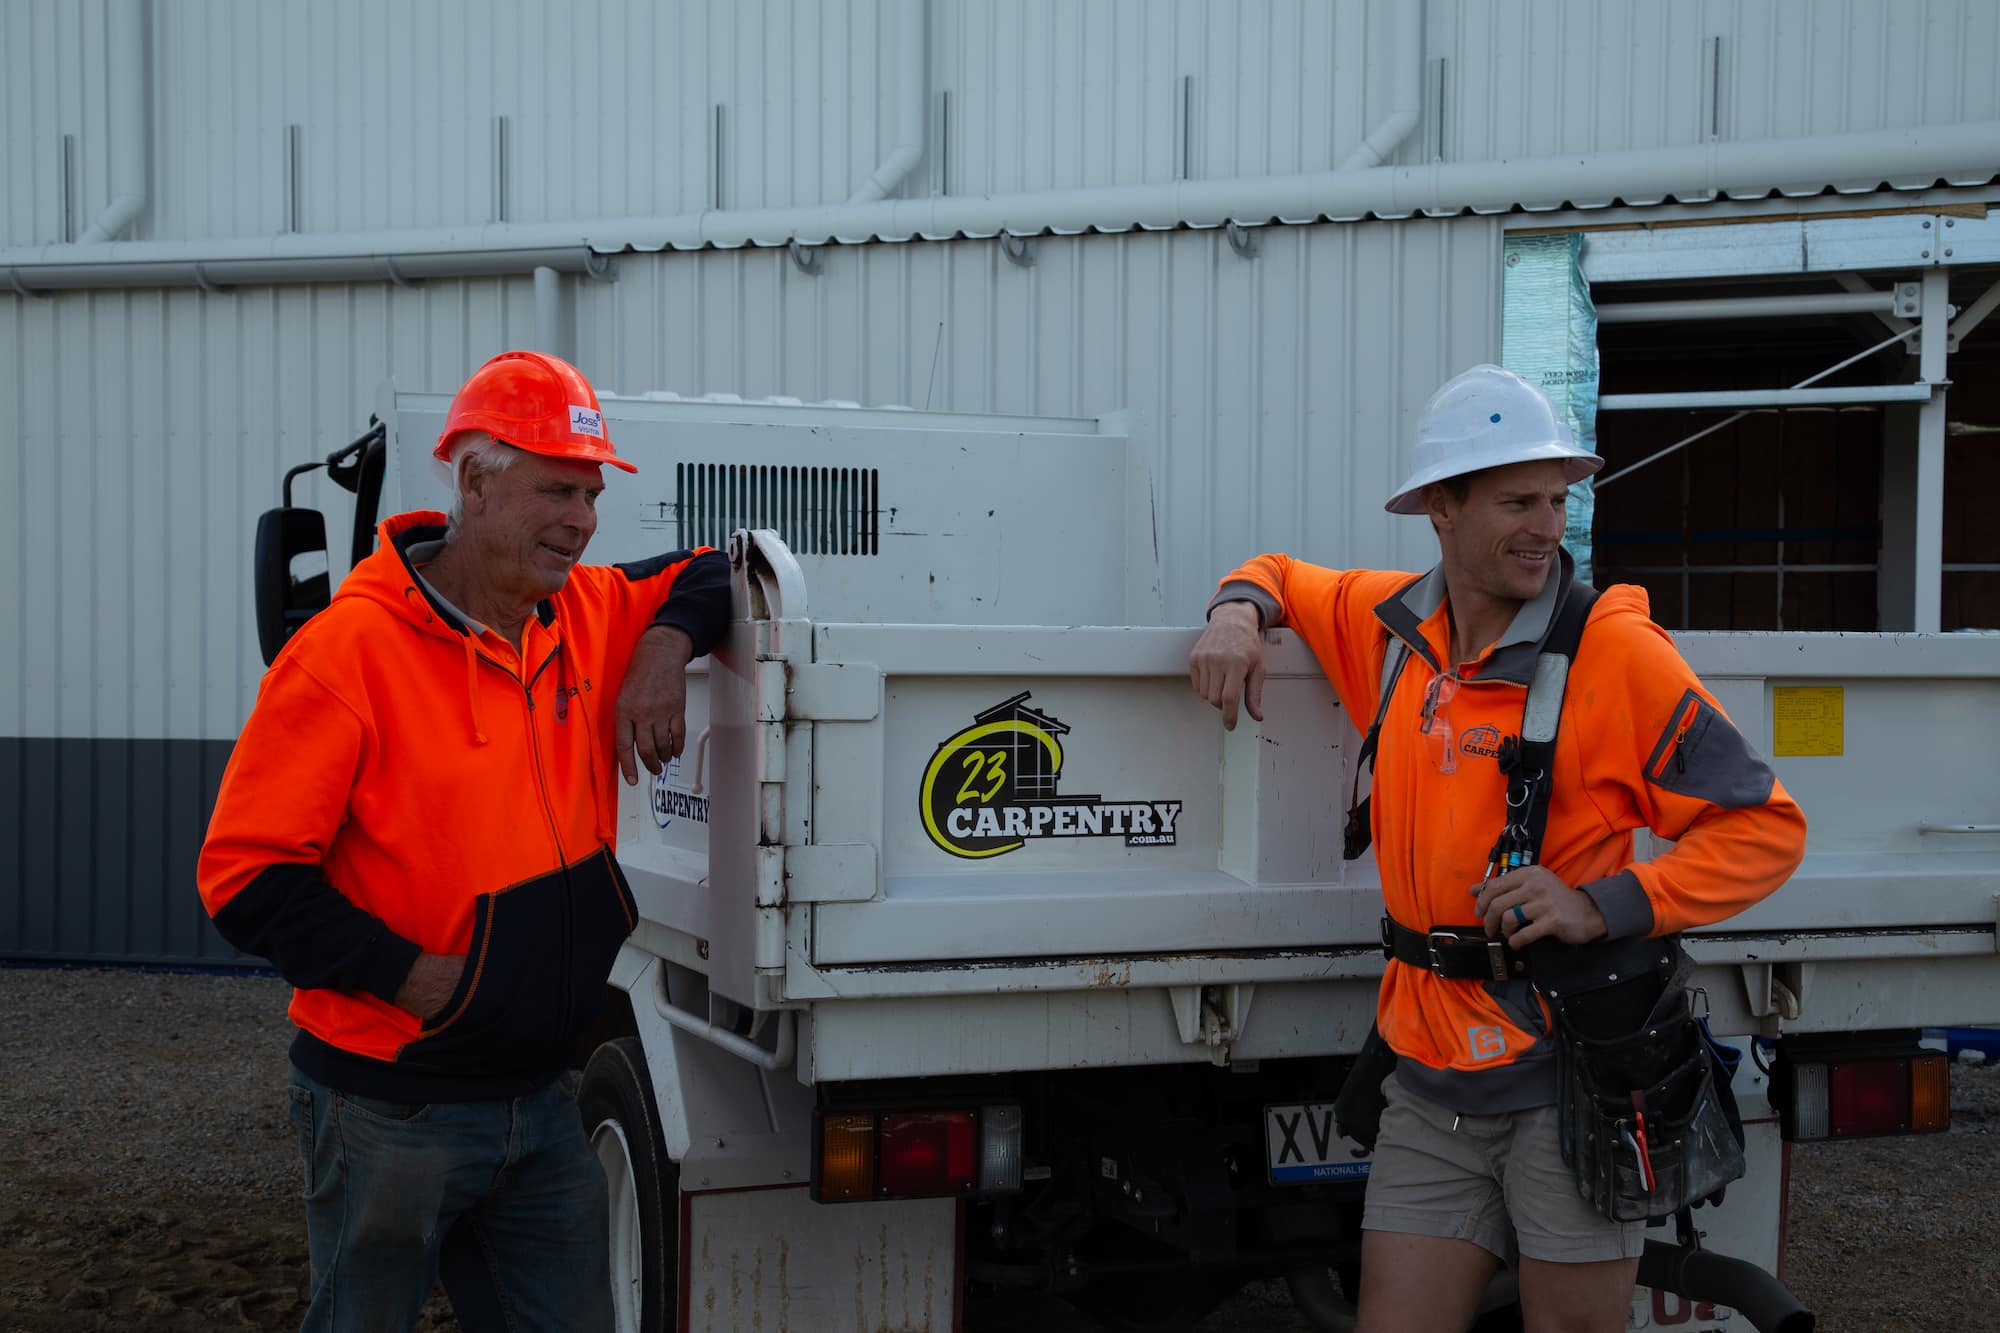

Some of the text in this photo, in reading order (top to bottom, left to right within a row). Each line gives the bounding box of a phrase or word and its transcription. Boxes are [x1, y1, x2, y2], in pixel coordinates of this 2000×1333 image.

[572, 411, 599, 427] Joss
[1464, 744, 1500, 758] CARPE
[956, 750, 1007, 804] 23
[655, 789, 710, 823] CARPENTRY
[947, 803, 1180, 838] CARPENTRY
[1129, 834, 1174, 844] .com.au
[1275, 1110, 1370, 1164] XV
[1313, 1164, 1370, 1177] NATIONAL HE
